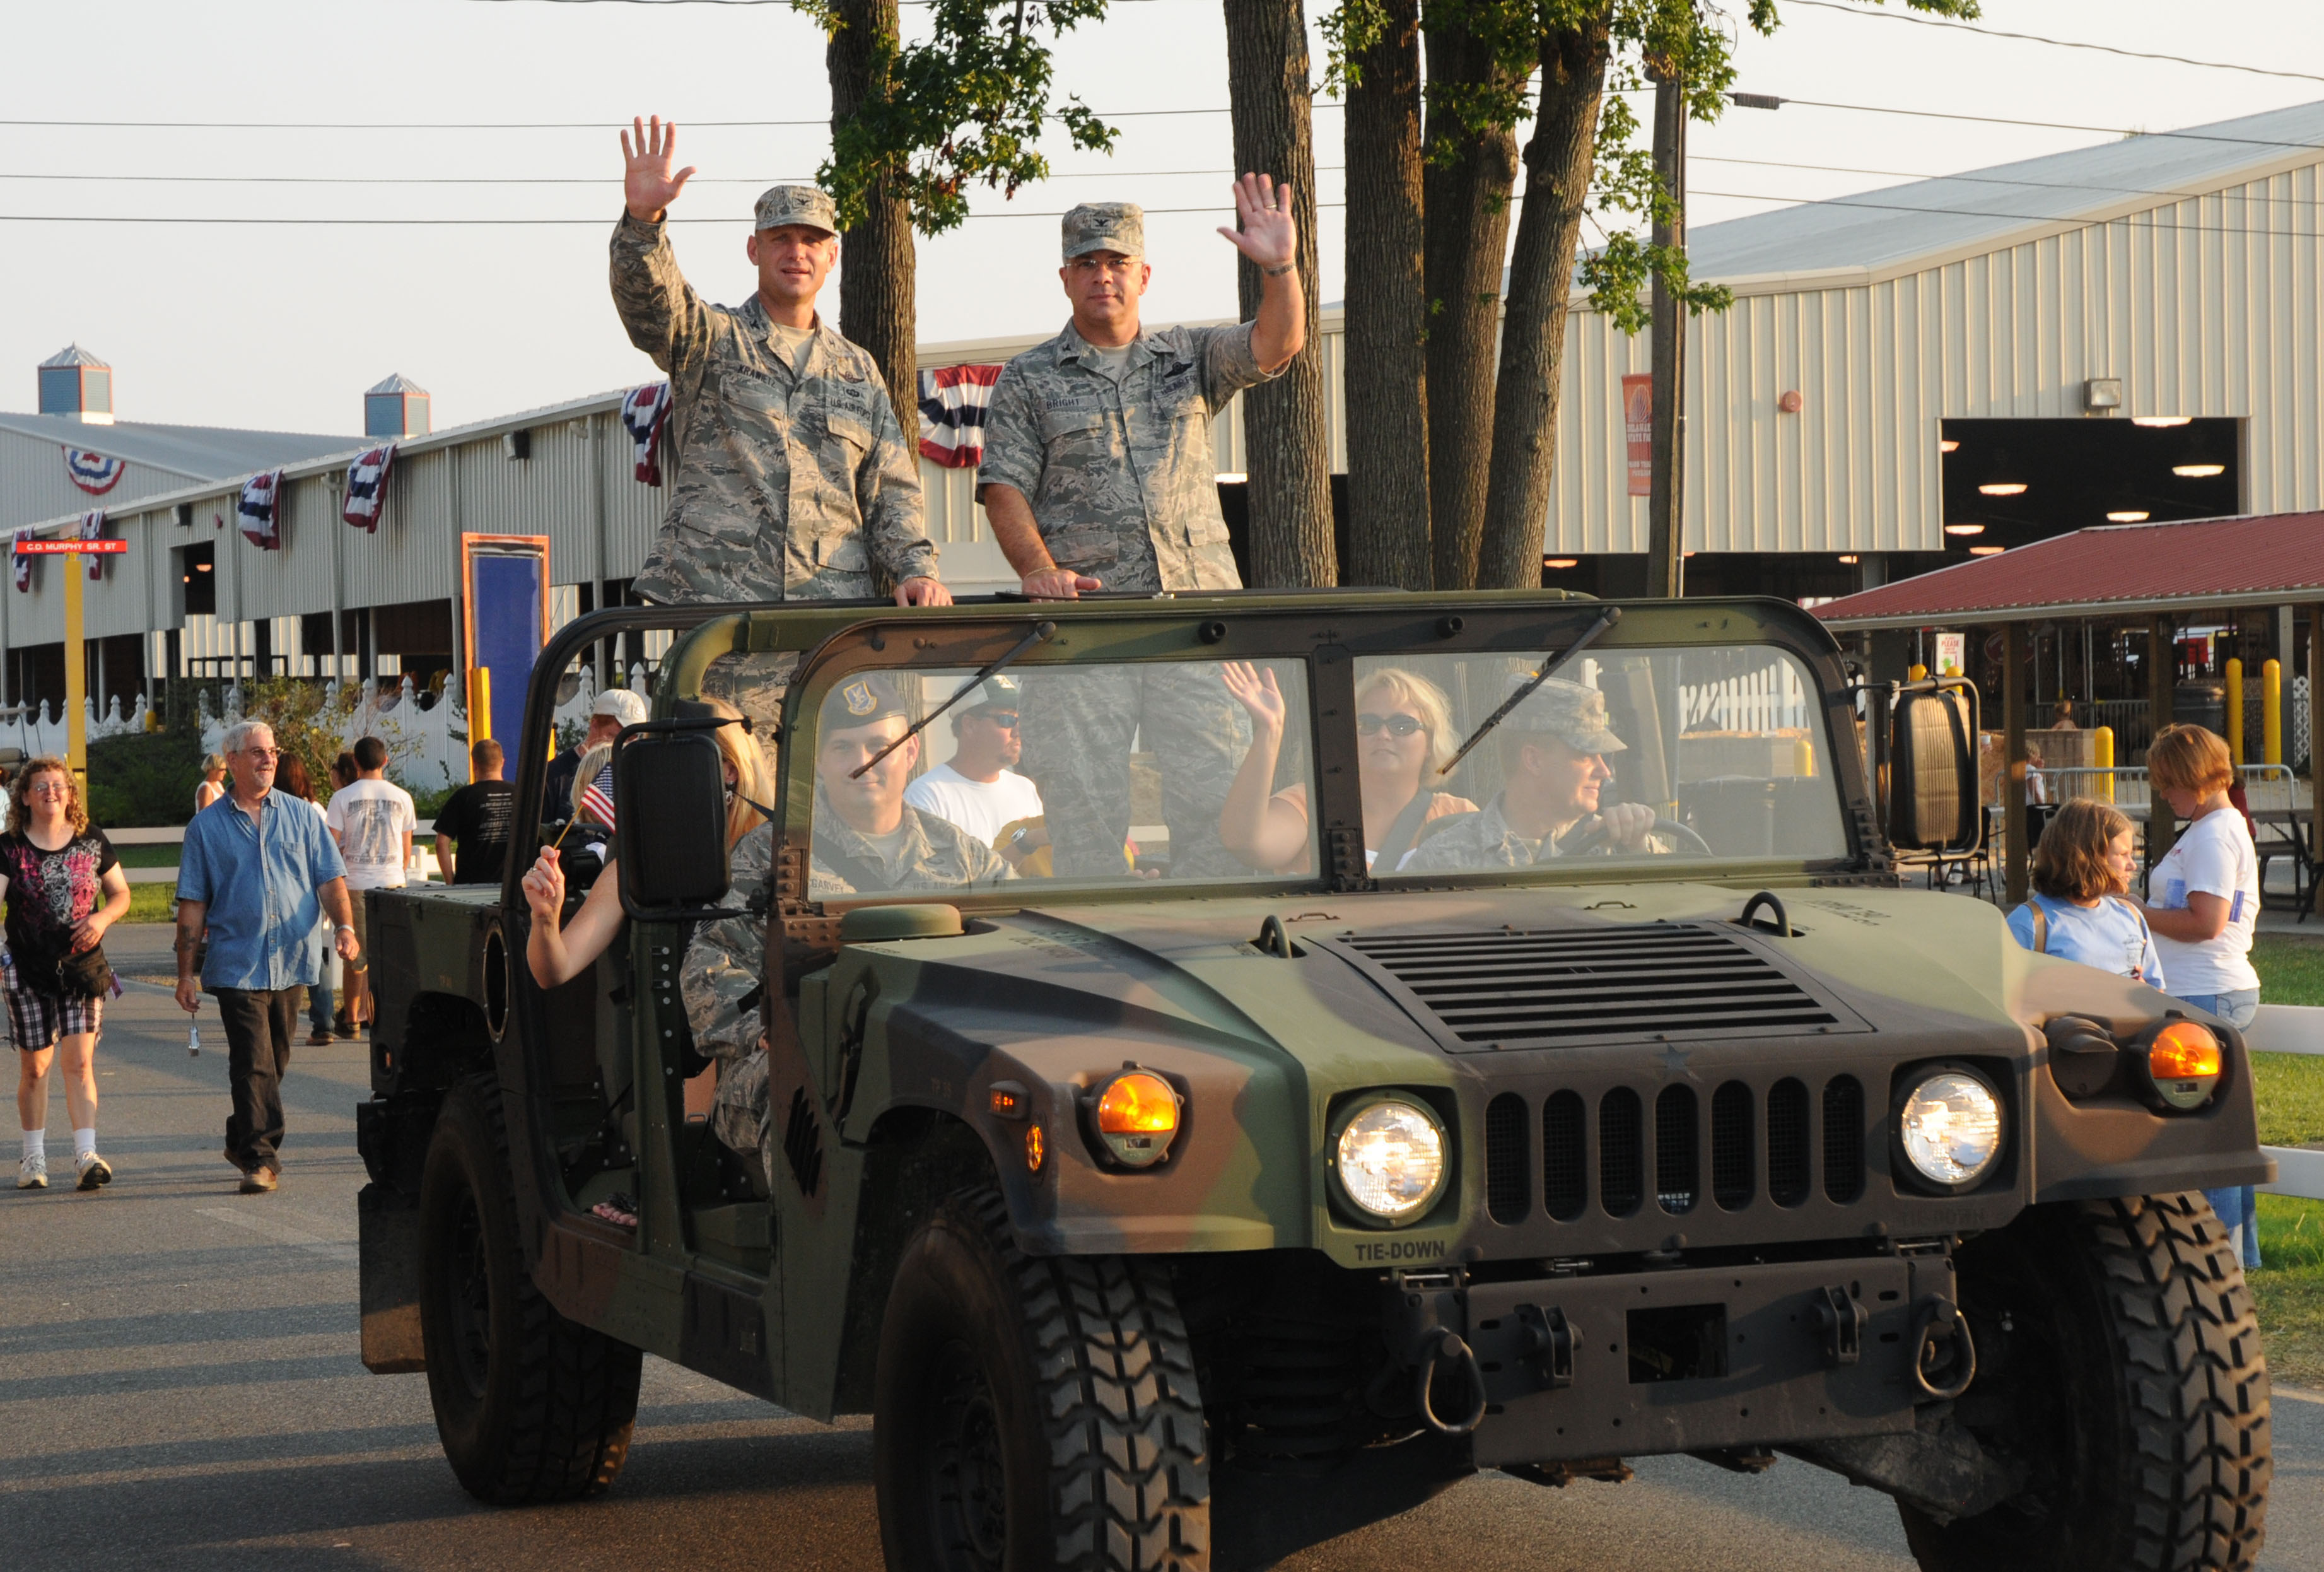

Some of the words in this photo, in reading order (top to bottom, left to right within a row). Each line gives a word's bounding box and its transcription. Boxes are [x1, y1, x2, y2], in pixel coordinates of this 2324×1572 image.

[737, 364, 776, 389] KRAWIETZ
[844, 402, 856, 411] AIR
[1046, 398, 1080, 410] BRIGHT
[1355, 1240, 1445, 1261] TIE-DOWN
